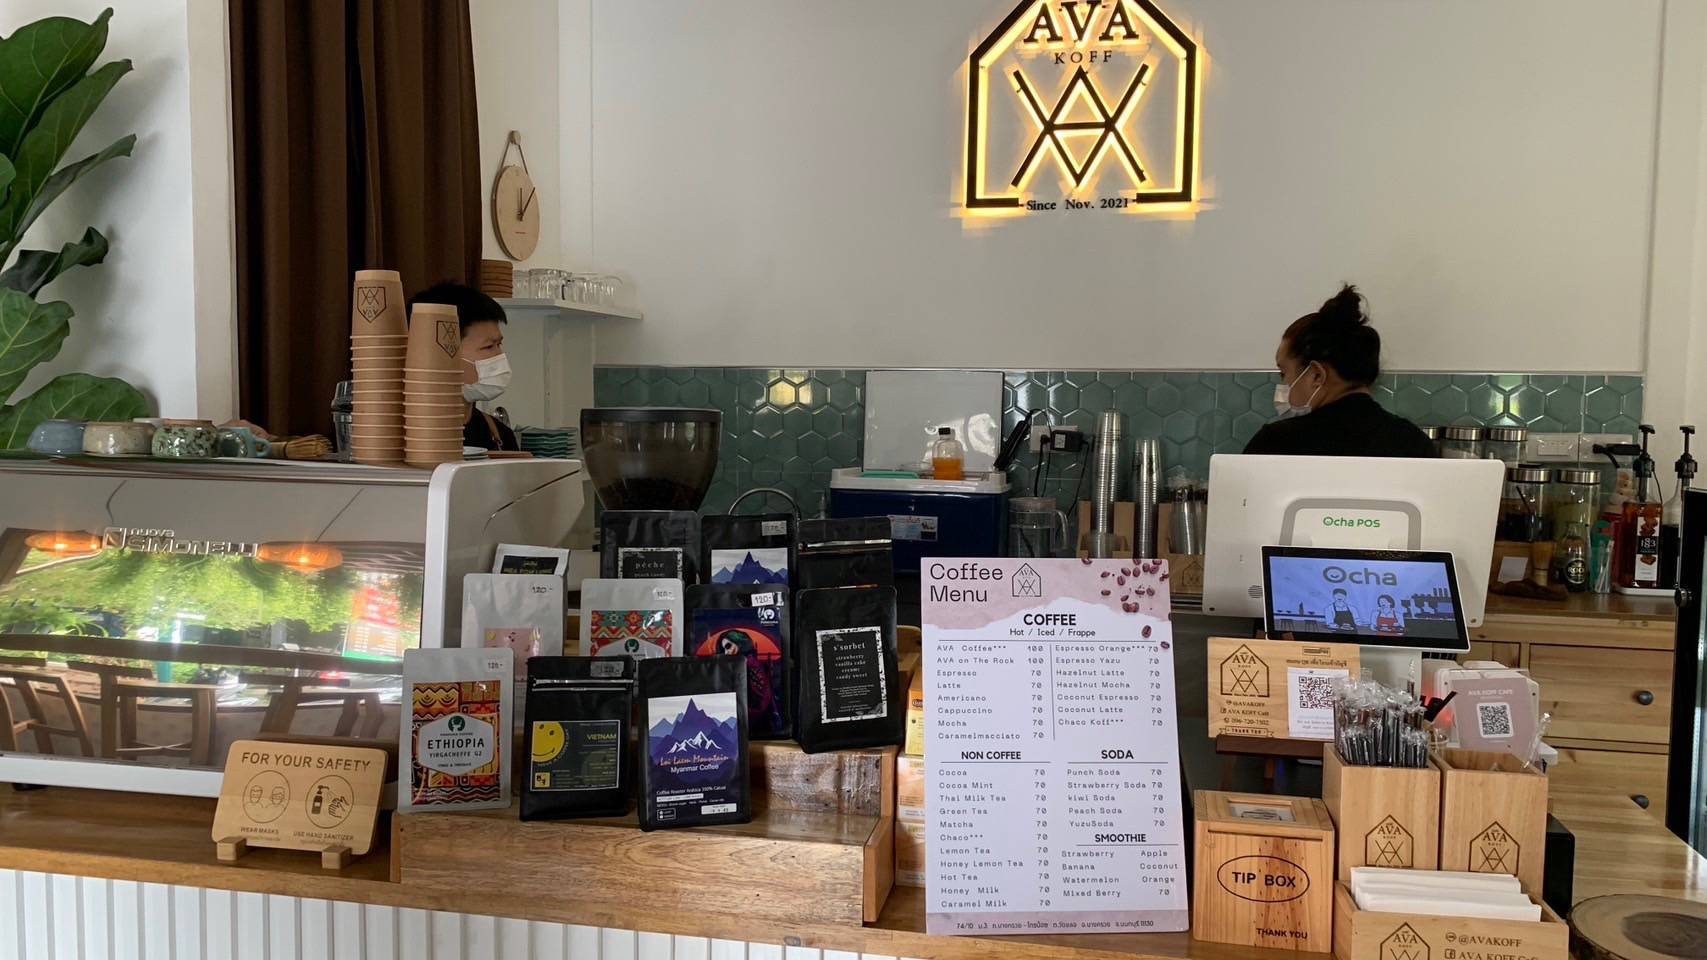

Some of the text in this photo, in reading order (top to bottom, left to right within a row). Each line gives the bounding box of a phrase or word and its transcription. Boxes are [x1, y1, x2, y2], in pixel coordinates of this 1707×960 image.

[1024, 1, 1139, 42] AVA
[1054, 50, 1113, 64] KOFF
[1026, 198, 1129, 211] Since Nov. 2021
[1323, 516, 1381, 528] Ocha POS
[930, 563, 1003, 580] Coffee
[1323, 566, 1398, 586] Ocha
[931, 585, 987, 602] Menu
[1024, 614, 1076, 625] COFFEE
[1010, 628, 1095, 638] Hot Iced Frappe
[1056, 657, 1095, 665] Espresso
[1232, 655, 1256, 664] AVA
[587, 733, 617, 741] VIETNAM
[427, 737, 485, 750] ETHIOPIA
[961, 751, 1021, 759] NON COFFEE
[1101, 750, 1134, 759] SODA
[241, 752, 371, 772] FOR YOUR SAFETY
[670, 764, 719, 774] Myanmar Coffee
[939, 768, 967, 776] Cocoa
[1068, 782, 1119, 790] Strawberry
[240, 826, 258, 834] WEAR
[1377, 825, 1402, 835] AVA
[323, 833, 354, 841] SANITIZER
[1095, 834, 1146, 842] SMOOTHIE
[1483, 832, 1507, 842] AVA
[1062, 849, 1167, 858] Strawberry Apple
[941, 861, 968, 869] Honey
[1142, 876, 1174, 884] Orange
[1232, 871, 1297, 888] TIP BOX
[978, 886, 998, 894] Milk
[1096, 890, 1120, 898] Berry
[941, 900, 981, 908] Caramel
[1256, 927, 1308, 940] THANK YOU
[1393, 934, 1418, 944] AVA
[1458, 935, 1522, 948] @AVAKOFF
